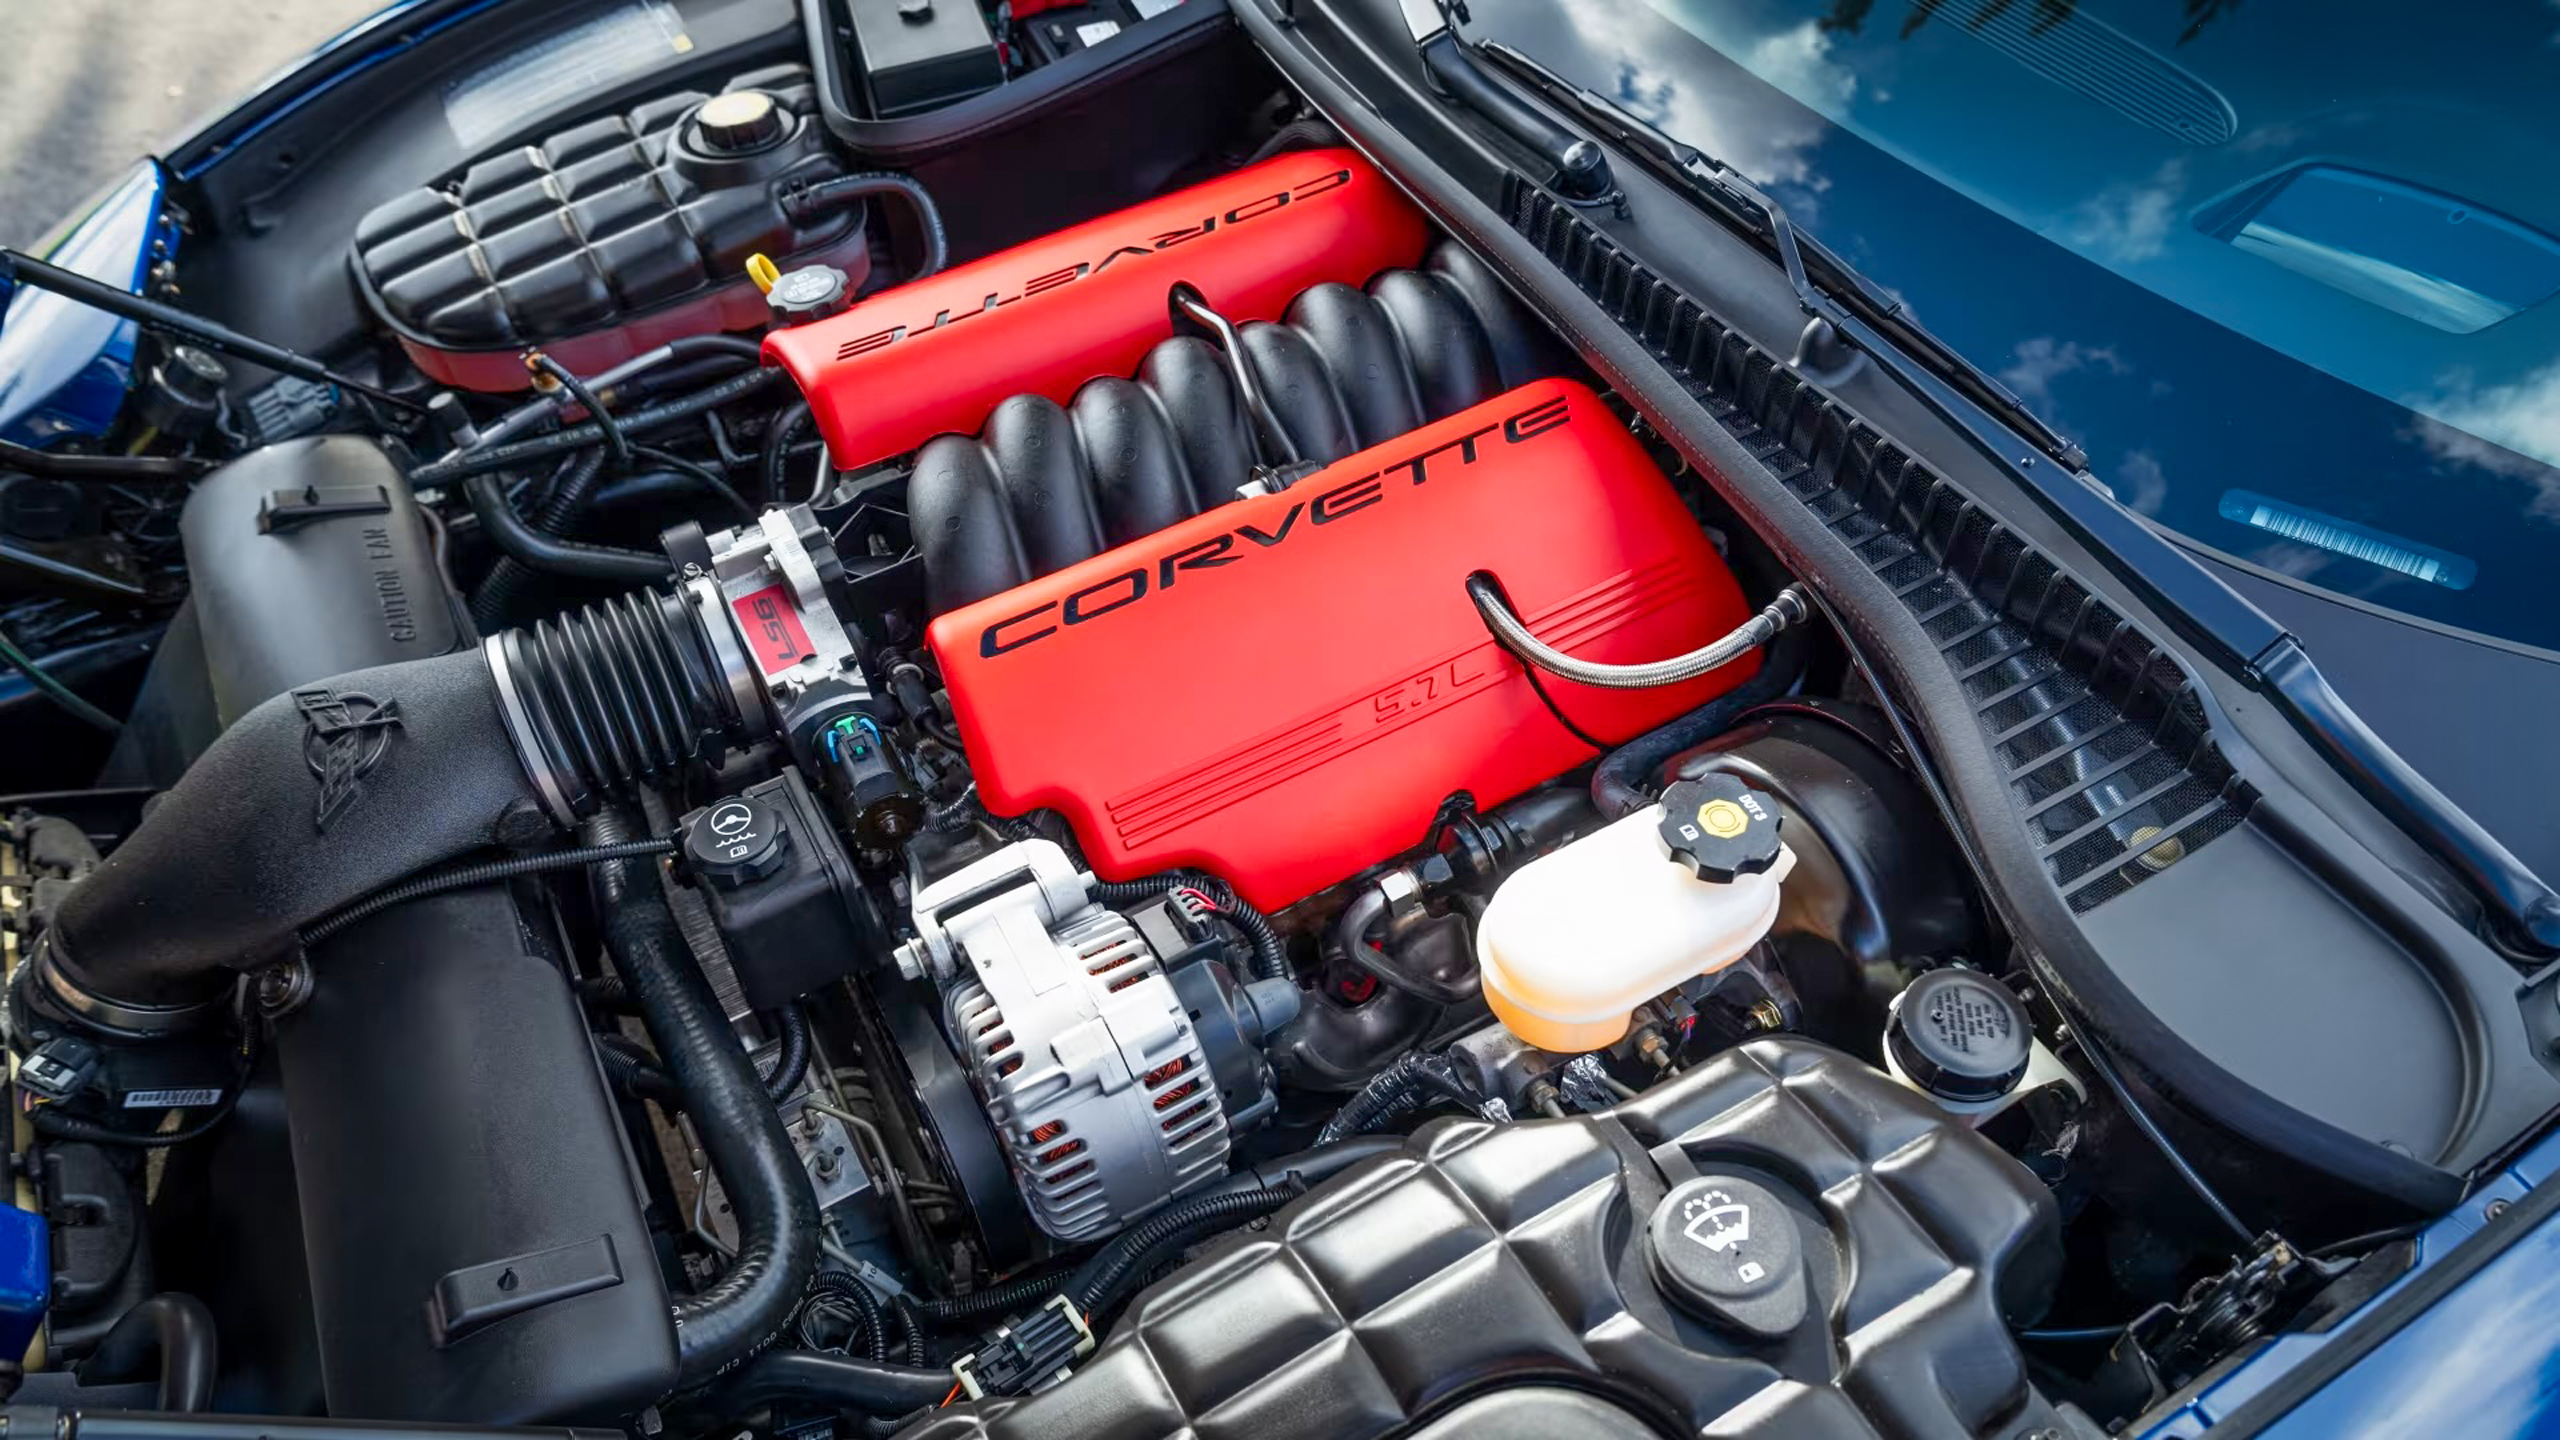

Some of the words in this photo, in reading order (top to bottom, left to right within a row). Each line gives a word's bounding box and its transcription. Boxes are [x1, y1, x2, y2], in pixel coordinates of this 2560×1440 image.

[836, 169, 1350, 361] CORVETTE
[362, 528, 394, 560] FAN
[980, 394, 1571, 659] CORVETTE
[374, 568, 416, 642] CAUTION
[752, 597, 799, 660] LS6
[1738, 794, 1763, 814] DOT
